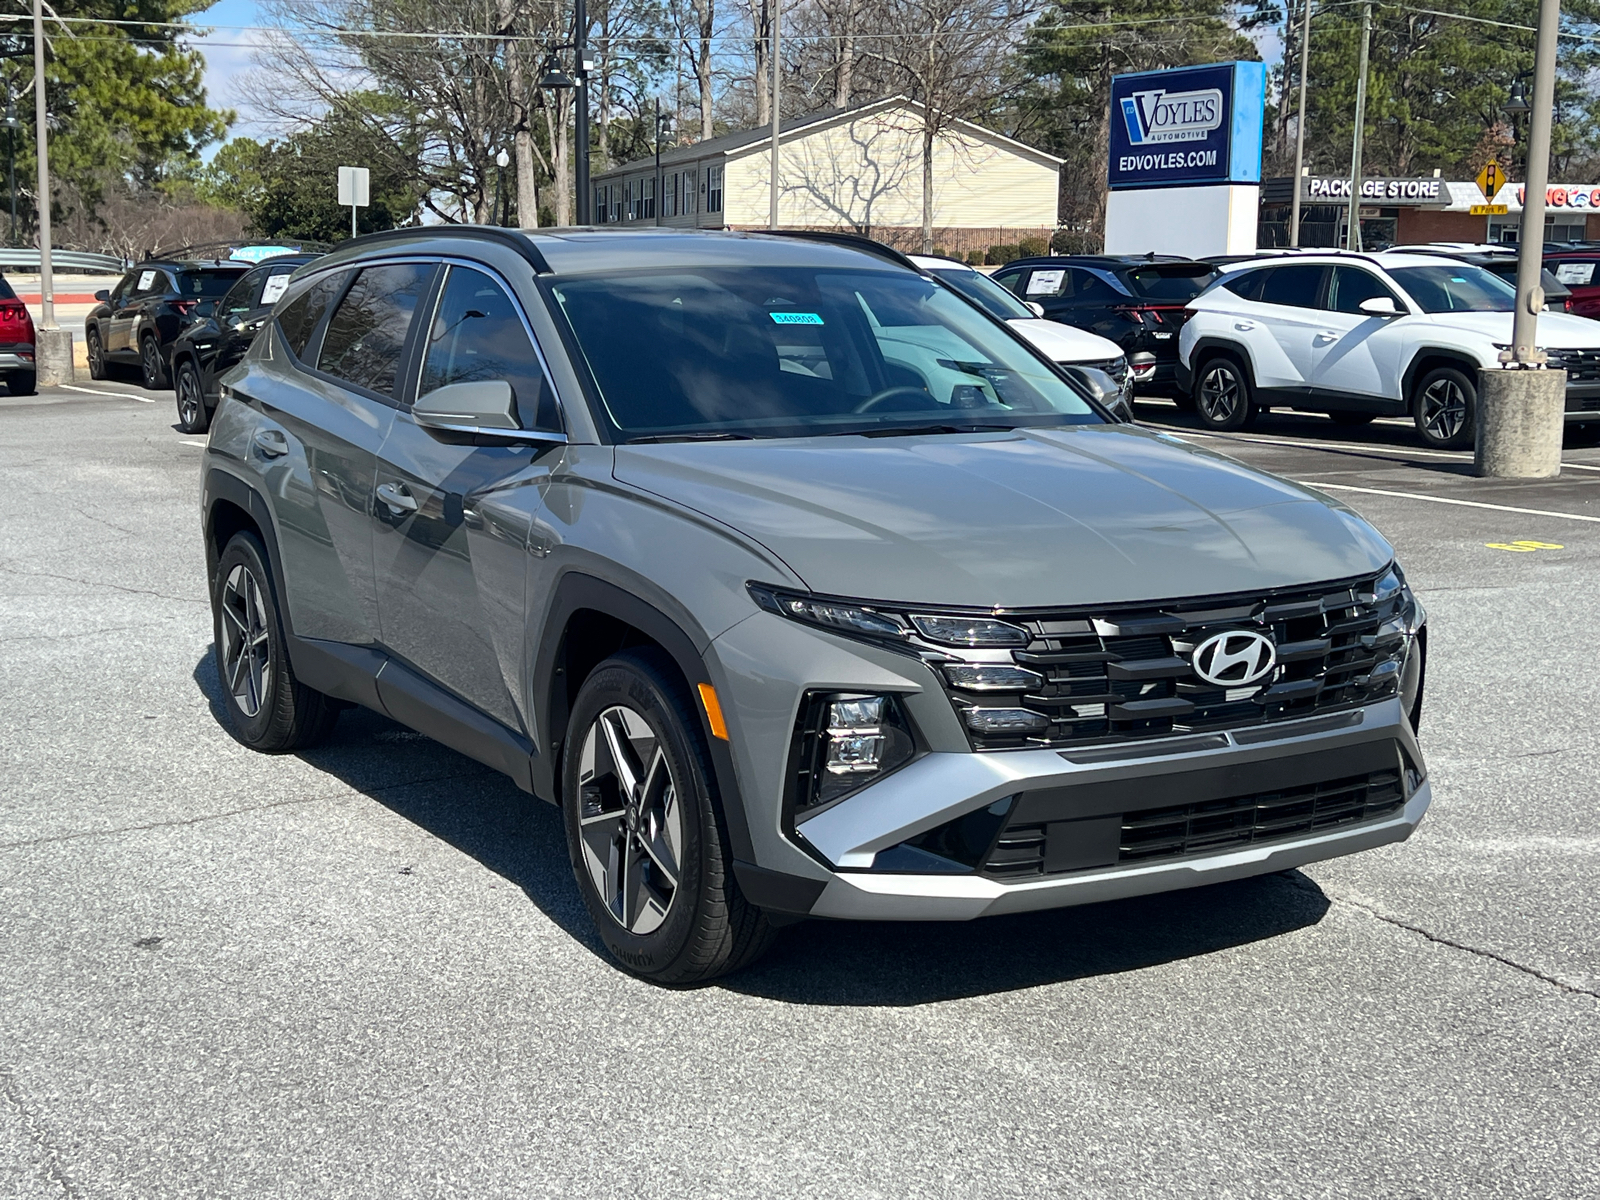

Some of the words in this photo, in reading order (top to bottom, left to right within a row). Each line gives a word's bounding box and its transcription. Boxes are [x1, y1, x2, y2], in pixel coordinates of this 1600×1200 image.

[1126, 106, 1135, 114] ED
[1135, 93, 1215, 138] VOYLES
[1151, 130, 1206, 141] AUTOMOTIVE
[1119, 150, 1217, 171] EDVOYLES.COM
[1310, 179, 1385, 196] PACKGE
[1388, 181, 1440, 196] STORE
[1481, 205, 1495, 213] Park
[232, 249, 256, 258] Now
[611, 944, 655, 966] KUMHO
